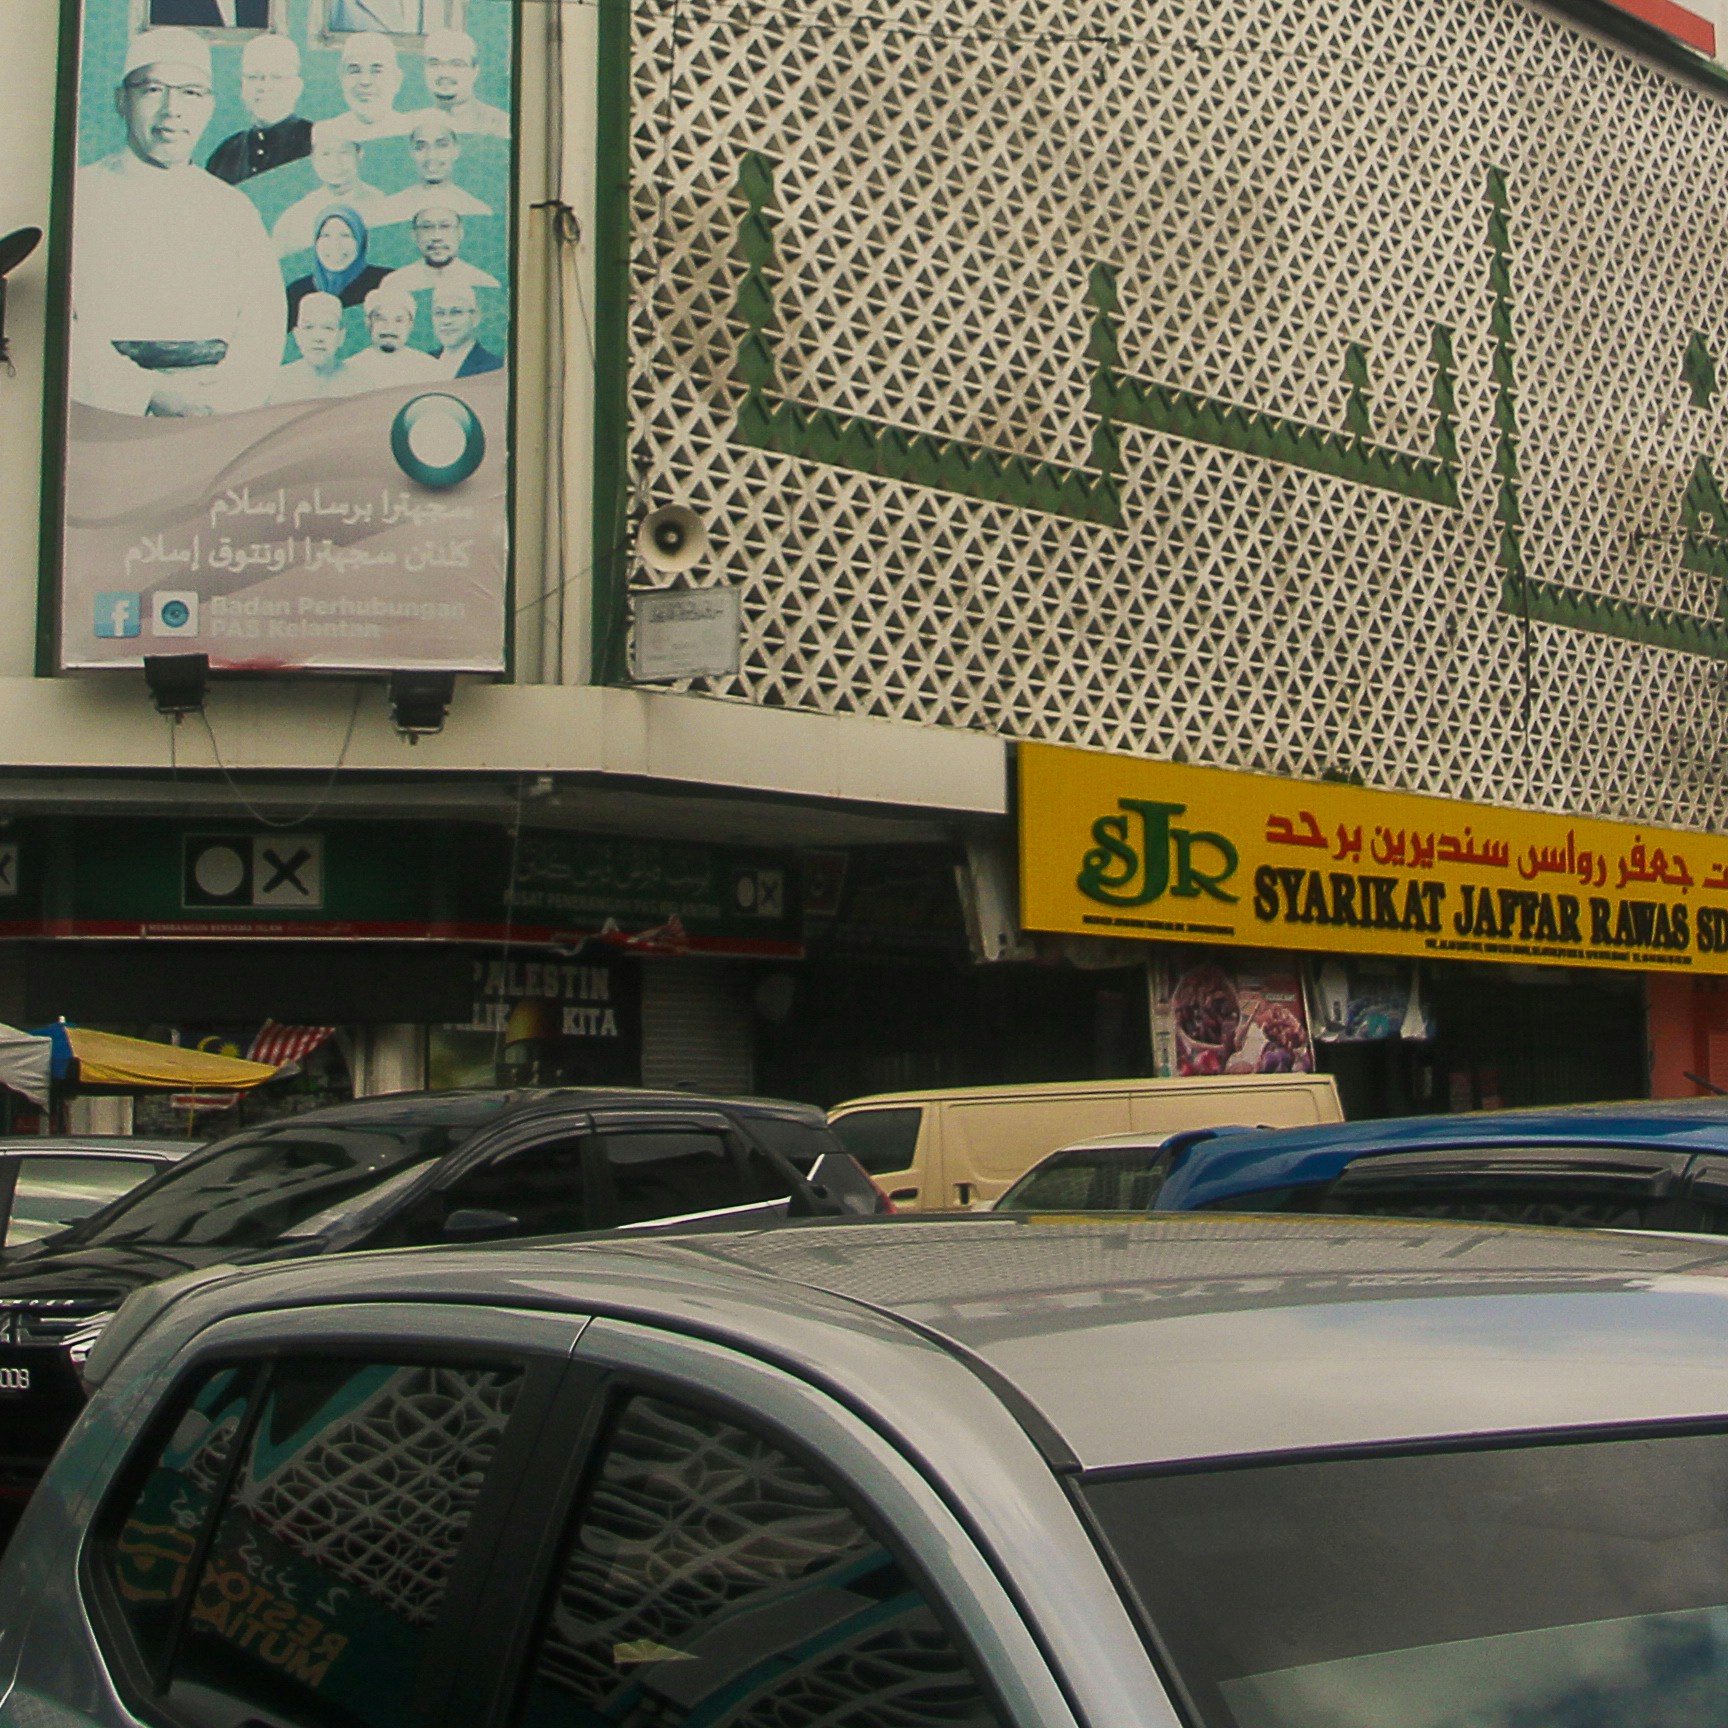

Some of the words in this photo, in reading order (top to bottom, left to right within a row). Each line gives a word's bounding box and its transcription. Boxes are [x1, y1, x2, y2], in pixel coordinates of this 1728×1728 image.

[211, 594, 289, 616] Badan
[299, 596, 466, 621] Perhubungan
[1615, 834, 1694, 895] جعفر
[1253, 864, 1446, 932] SYARIKAT
[1453, 884, 1583, 944] JAFFAR
[1589, 896, 1690, 951] RAWAS
[562, 1006, 618, 1037] KITA
